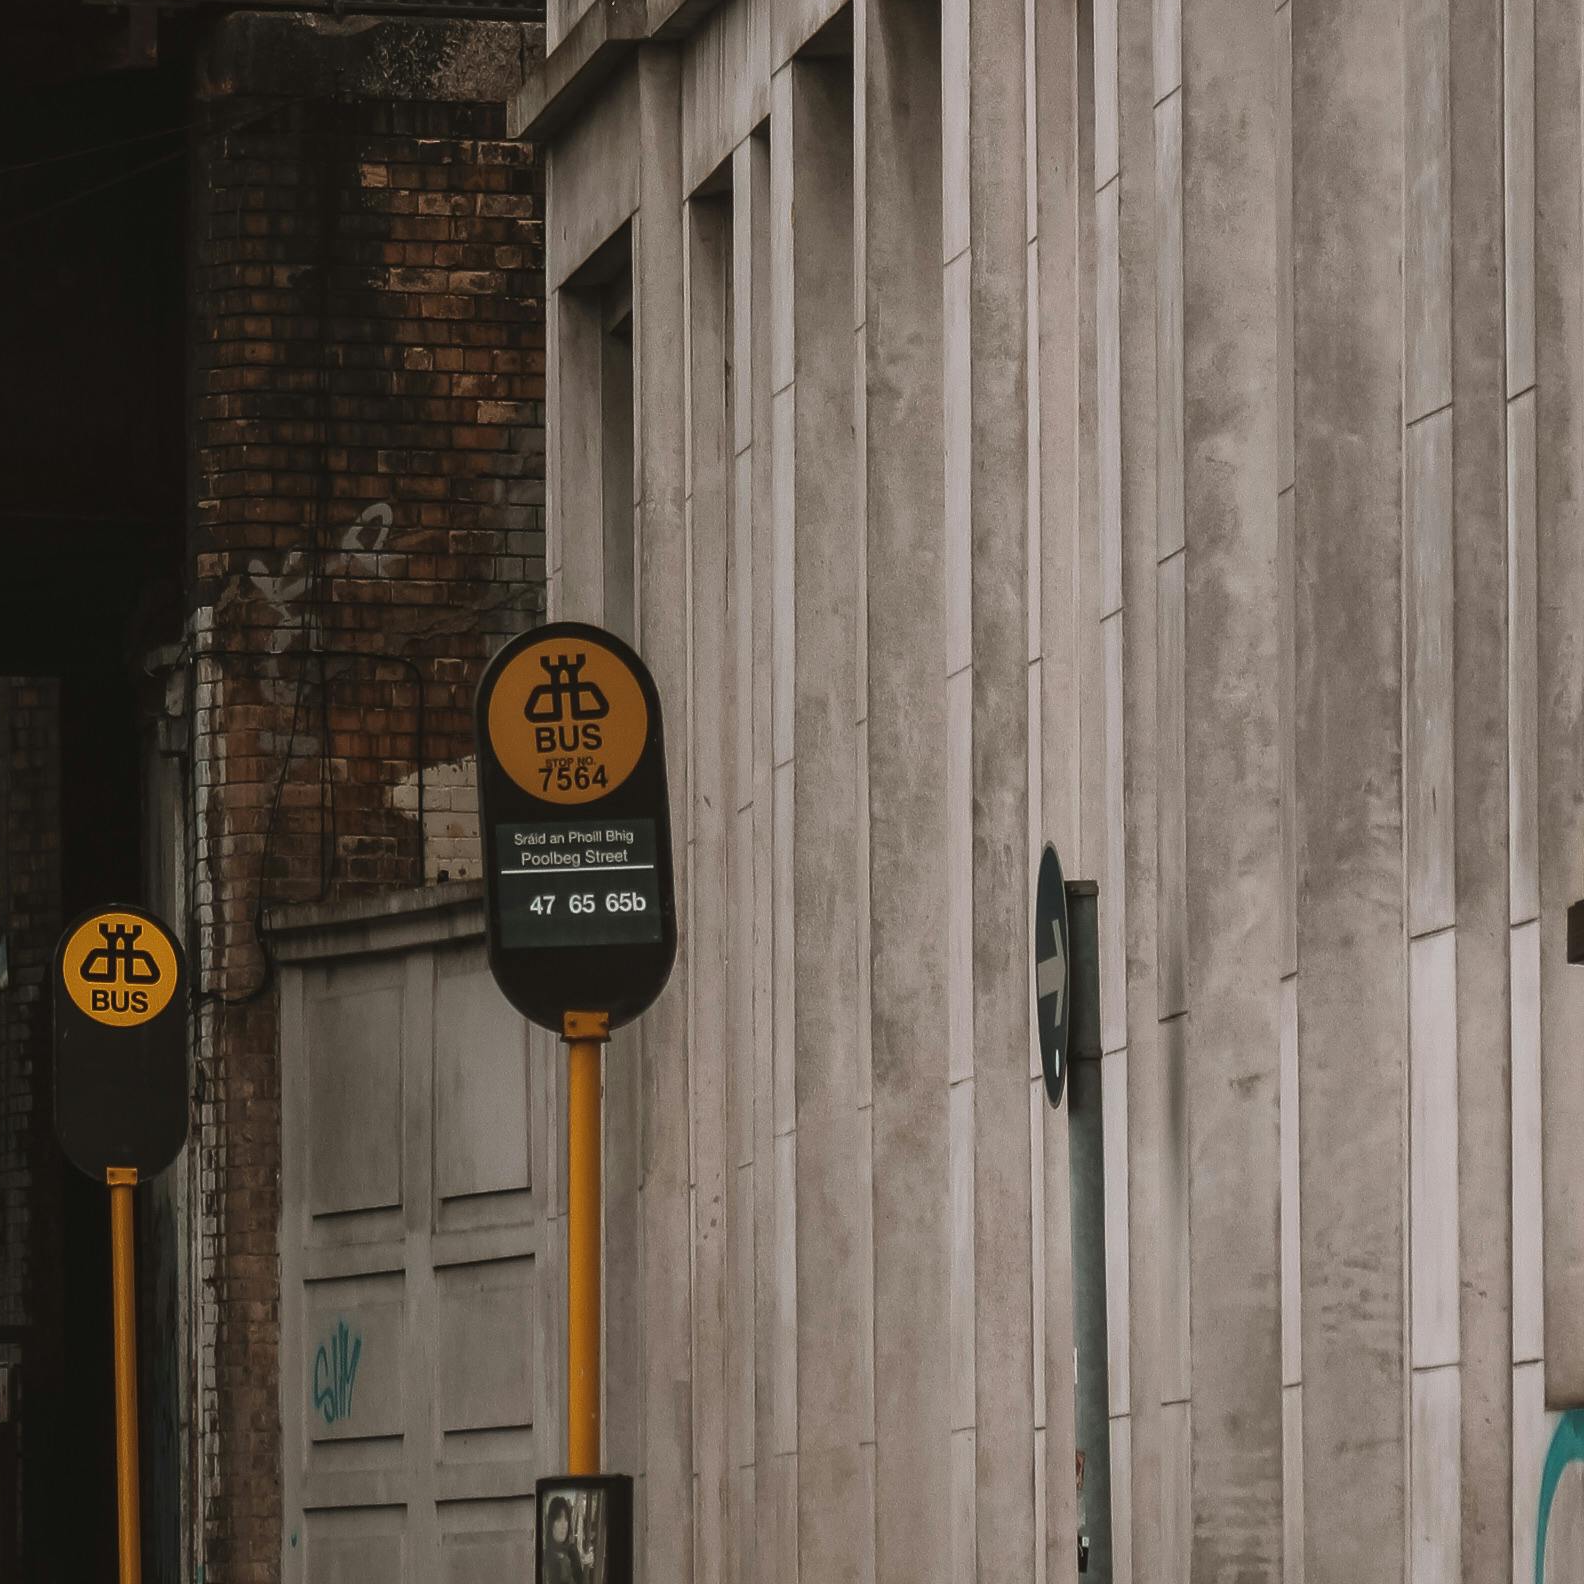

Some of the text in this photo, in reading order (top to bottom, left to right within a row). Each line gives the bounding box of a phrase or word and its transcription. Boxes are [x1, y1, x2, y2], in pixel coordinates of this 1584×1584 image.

[535, 723, 603, 753] BUS
[545, 758, 574, 768] STOP
[538, 764, 608, 792] 7564
[514, 829, 634, 846] Sráid an Phoill Bhig
[521, 849, 628, 867] Poolbeg Street
[529, 892, 647, 915] 47 65 65b
[91, 989, 149, 1013] BUS
